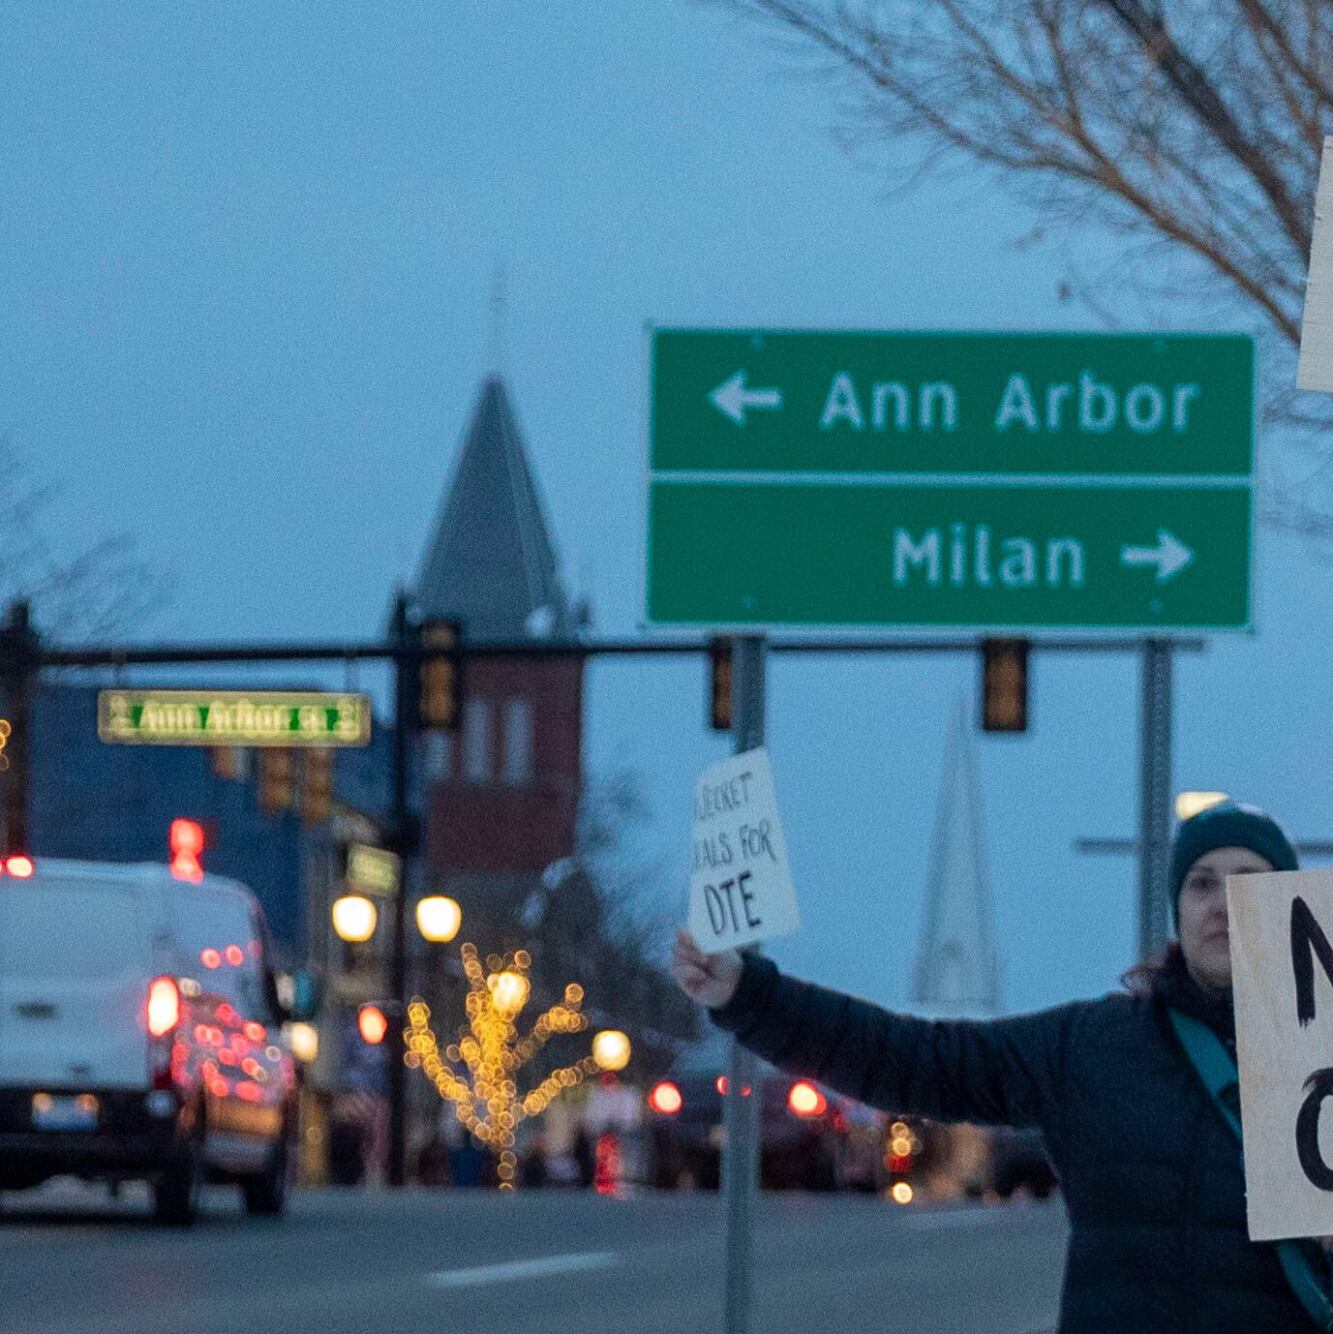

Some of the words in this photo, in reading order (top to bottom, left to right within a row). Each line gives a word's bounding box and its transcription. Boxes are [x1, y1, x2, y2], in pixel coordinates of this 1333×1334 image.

[819, 371, 959, 431] Ann
[995, 368, 1199, 433] Arbor
[892, 523, 1086, 588] Milan
[694, 831, 733, 870] ALS
[739, 818, 778, 862] FOR
[704, 870, 762, 936] DTE
